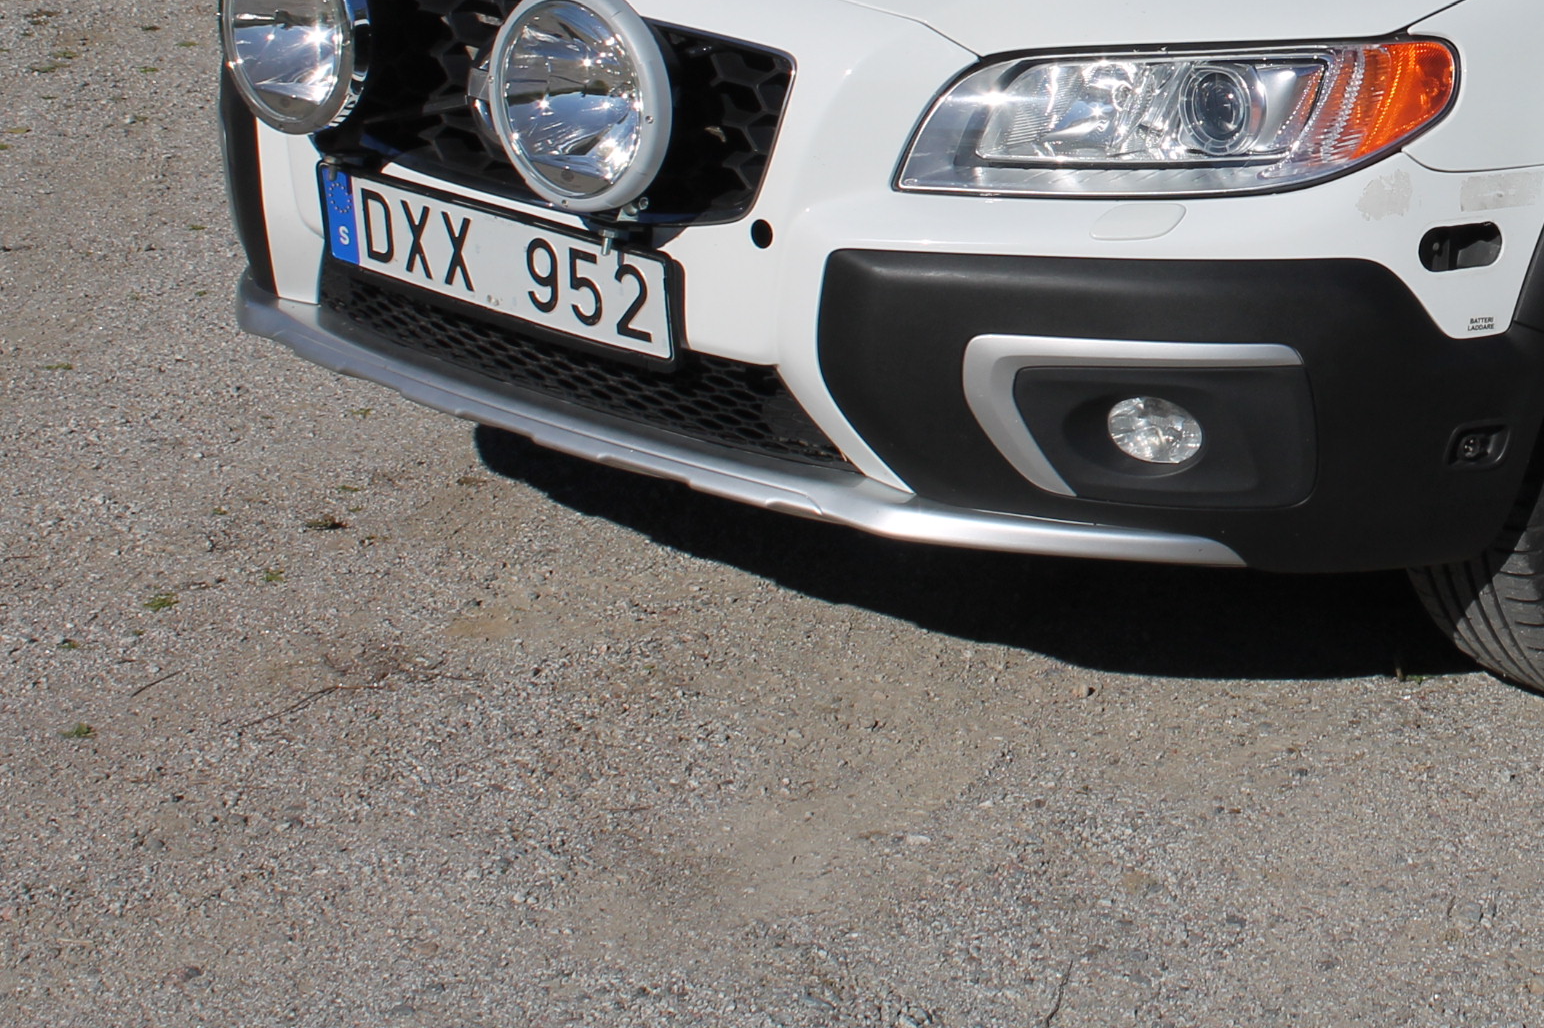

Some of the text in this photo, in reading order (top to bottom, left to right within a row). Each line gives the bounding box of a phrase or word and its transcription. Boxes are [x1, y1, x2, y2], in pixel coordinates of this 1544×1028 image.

[338, 187, 653, 343] S DXX 952
[1469, 316, 1494, 324] BATTERI
[1467, 323, 1495, 331] LADDARE
